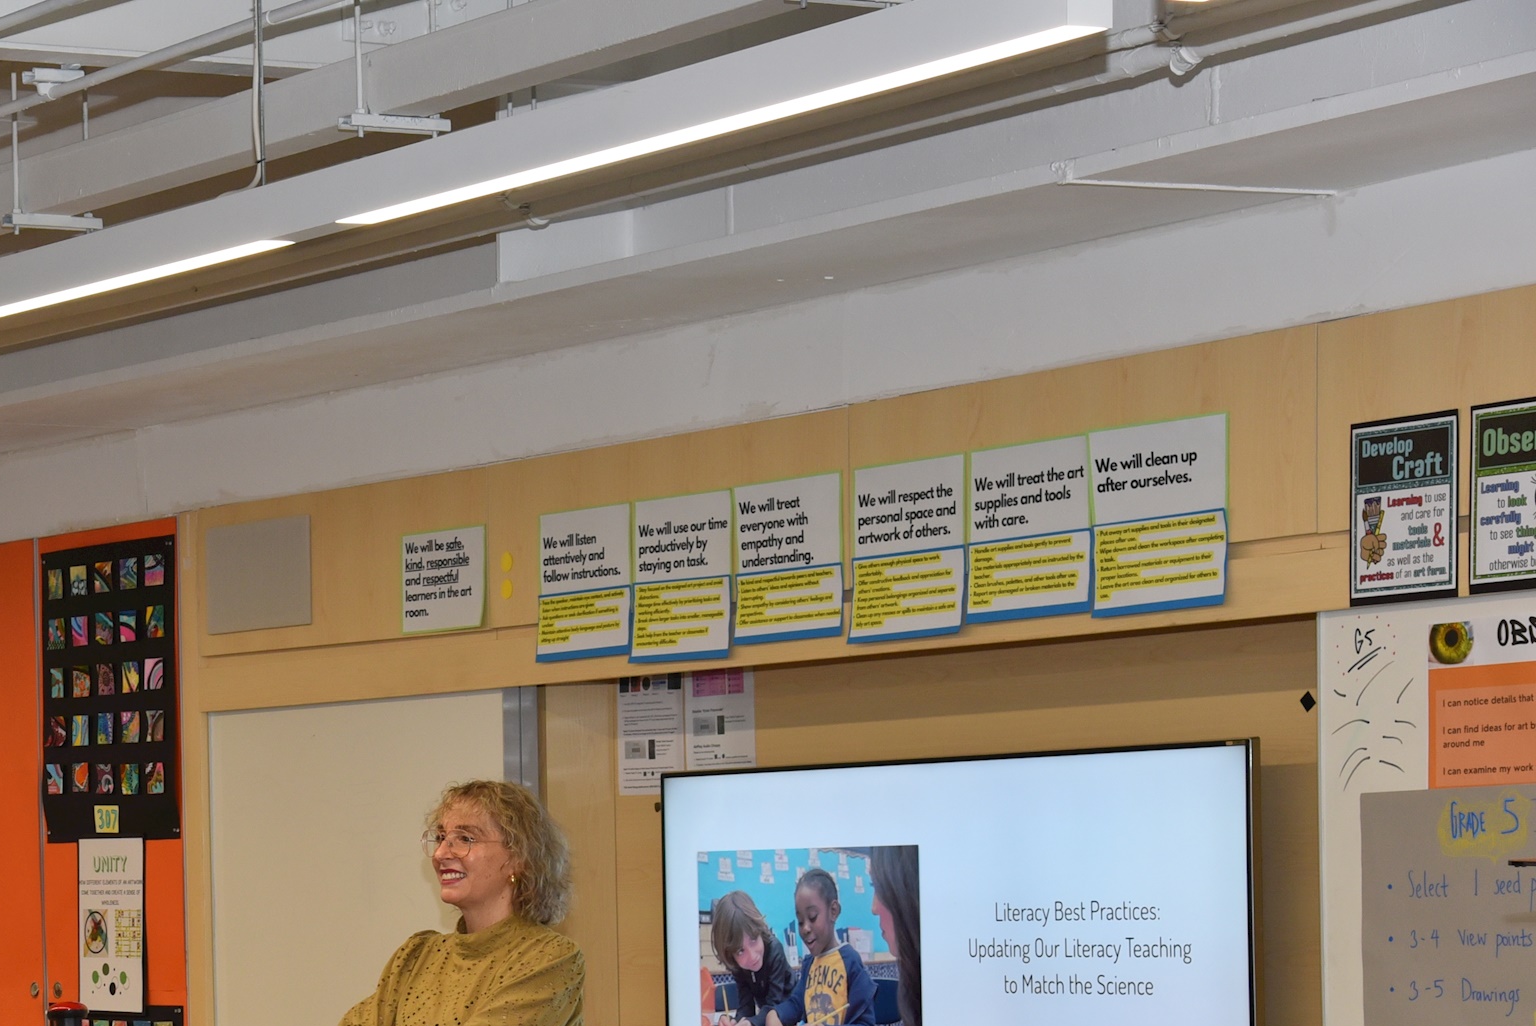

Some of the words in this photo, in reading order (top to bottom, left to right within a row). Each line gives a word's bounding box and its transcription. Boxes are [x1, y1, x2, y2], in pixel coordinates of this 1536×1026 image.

[1362, 437, 1413, 458] Develop
[1095, 458, 1117, 473] We
[1120, 454, 1142, 470] will
[1145, 452, 1178, 467] clean
[1181, 450, 1197, 465] up
[1392, 452, 1442, 480] Craft
[974, 477, 993, 492] We
[996, 475, 1014, 489] will
[1017, 470, 1045, 487] treat
[1047, 469, 1064, 484] the
[1066, 465, 1084, 479] art
[1097, 477, 1128, 493] after
[1131, 471, 1192, 488] ourselves.
[1481, 479, 1519, 494] Learning
[859, 493, 876, 508] We
[878, 491, 896, 505] will
[898, 486, 934, 503] respect
[936, 484, 953, 499] the
[974, 493, 1018, 511] supplies
[1021, 491, 1041, 505] and
[1044, 487, 1071, 502] tools
[1387, 494, 1422, 508] Learning
[1425, 493, 1432, 502] to
[1434, 492, 1446, 502] use
[1497, 498, 1505, 508] to
[1508, 495, 1527, 507] look
[739, 502, 755, 516] We
[758, 499, 773, 512] will
[776, 497, 800, 510] treat
[858, 509, 903, 528] personal
[905, 505, 933, 524] space
[936, 501, 955, 517] and
[1401, 511, 1413, 521] and
[1415, 509, 1431, 518] care
[1433, 506, 1444, 516] for
[740, 516, 784, 533] everyone
[787, 513, 808, 528] with
[974, 516, 999, 530] with
[1002, 513, 1029, 527] care.
[1480, 511, 1521, 526] carefully
[543, 537, 557, 550] We
[559, 535, 573, 548] will
[576, 533, 597, 547] listen
[741, 534, 783, 552] empathy
[785, 531, 804, 545] and
[858, 527, 901, 545] artwork
[903, 525, 913, 539] of
[915, 523, 951, 538] others.
[1408, 524, 1428, 535] tools
[1433, 523, 1444, 546] &
[1490, 530, 1497, 540] to
[1500, 530, 1513, 539] see
[405, 543, 418, 554] We
[420, 540, 433, 552] will
[435, 540, 444, 550] be
[446, 537, 464, 550] safe,
[1393, 537, 1431, 551] materials
[1508, 541, 1534, 556] might
[405, 558, 424, 570] kind,
[427, 553, 469, 570] responsible
[543, 552, 586, 569] attentively
[588, 548, 605, 562] and
[742, 551, 813, 569] understanding.
[1489, 557, 1528, 571] otherwise
[405, 574, 421, 586] and
[423, 570, 459, 586] respectful
[543, 569, 569, 583] follow
[571, 565, 621, 580] instructions.
[405, 591, 437, 602] learners
[439, 588, 445, 598] in
[447, 586, 459, 597] the
[460, 586, 472, 596] art
[405, 608, 429, 618] room.
[1464, 698, 1488, 706] notice
[1491, 696, 1516, 705] details
[1519, 694, 1533, 702] that
[97, 809, 117, 829] 307
[1451, 801, 1486, 838] GRADE
[1501, 798, 1519, 834] 5
[93, 856, 127, 872] UNITY
[1408, 870, 1448, 899] Select
[1494, 871, 1521, 895] seed
[995, 902, 1050, 927] Literacy
[1054, 901, 1085, 921] Best
[1090, 901, 1160, 921] Practices:
[968, 937, 1031, 963] Updating
[1035, 938, 1060, 958] Our
[1064, 938, 1121, 963] Literacy
[1126, 937, 1192, 964] Teaching
[1496, 929, 1533, 958] points
[1004, 975, 1017, 994] to
[1022, 974, 1064, 994] Match
[1069, 975, 1092, 994] the
[1097, 975, 1154, 996] Science
[1461, 978, 1520, 1016] Drawings
